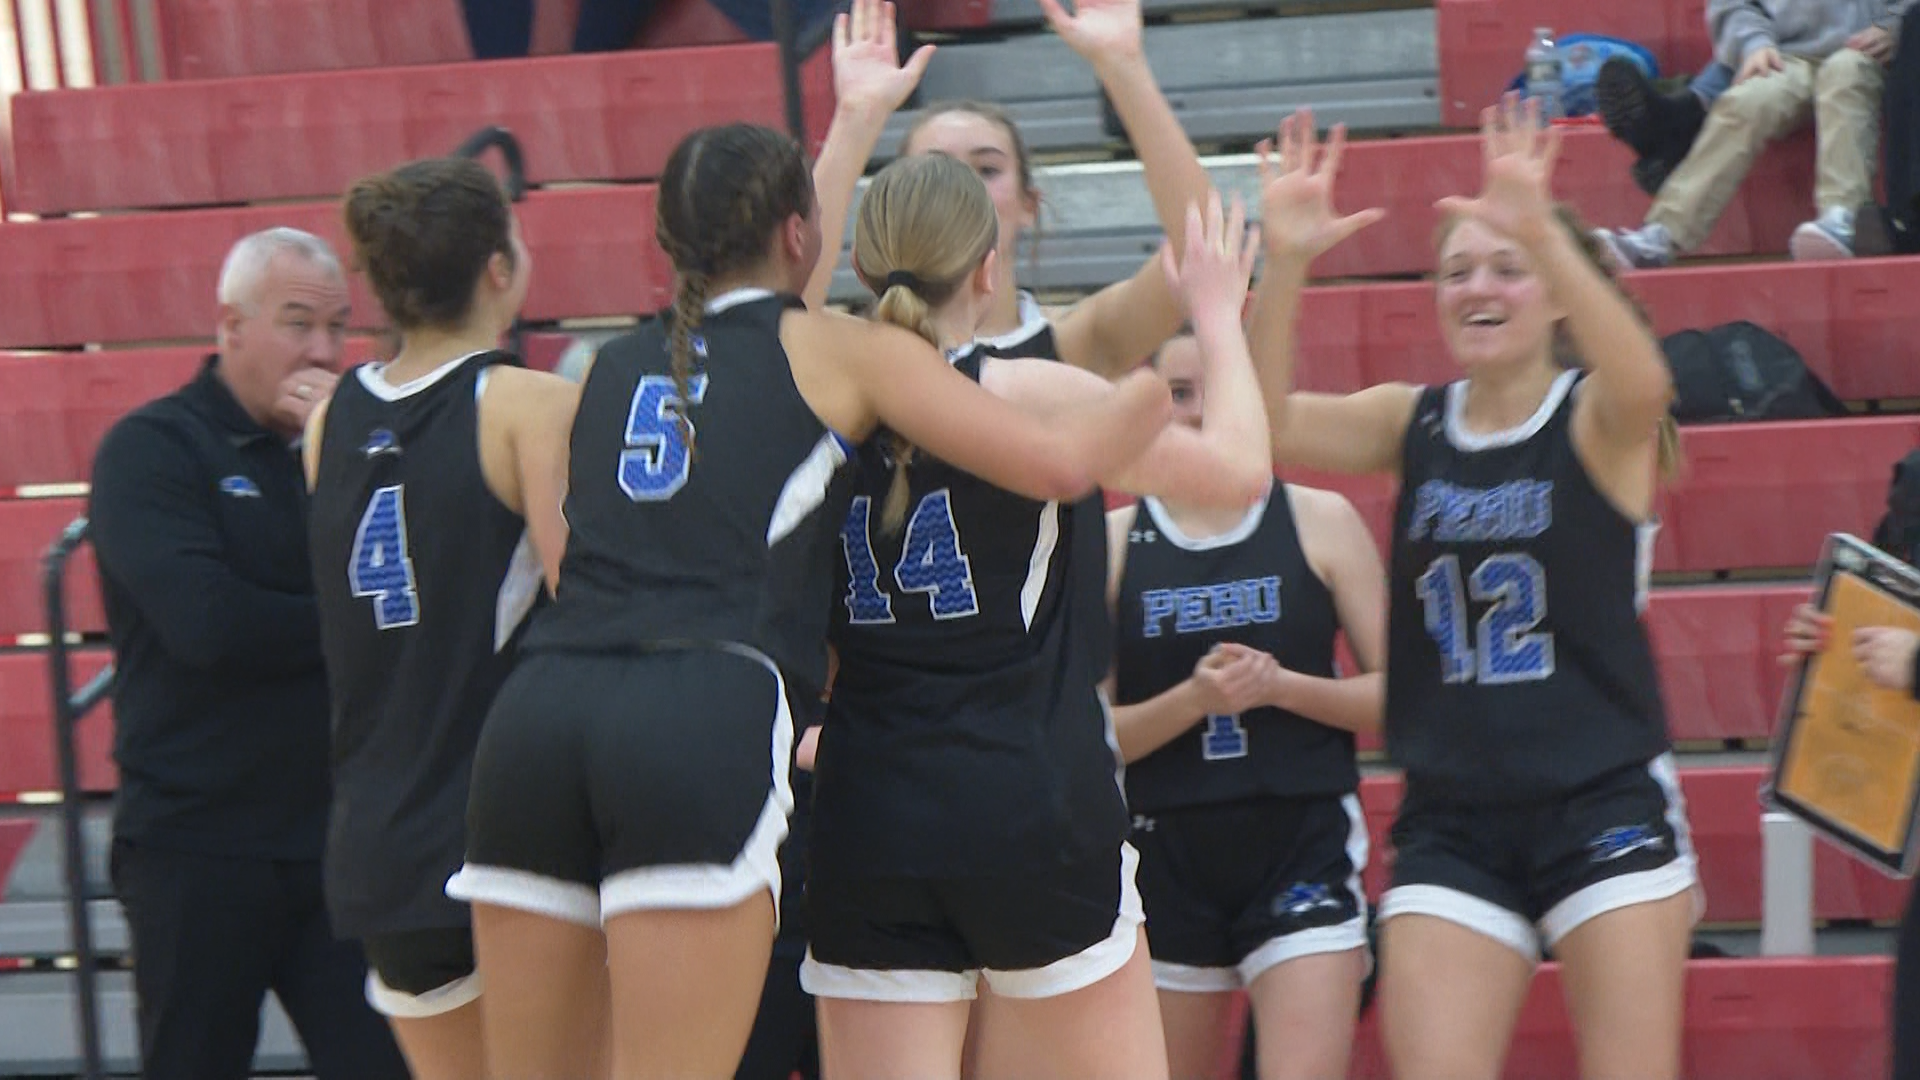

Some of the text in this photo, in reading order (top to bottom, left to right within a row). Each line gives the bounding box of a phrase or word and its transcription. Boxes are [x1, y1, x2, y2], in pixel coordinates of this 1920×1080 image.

[617, 373, 709, 501] 5
[348, 484, 420, 629] 4
[840, 488, 980, 624] 14
[1141, 575, 1282, 638] PERU
[1415, 553, 1556, 684] 12
